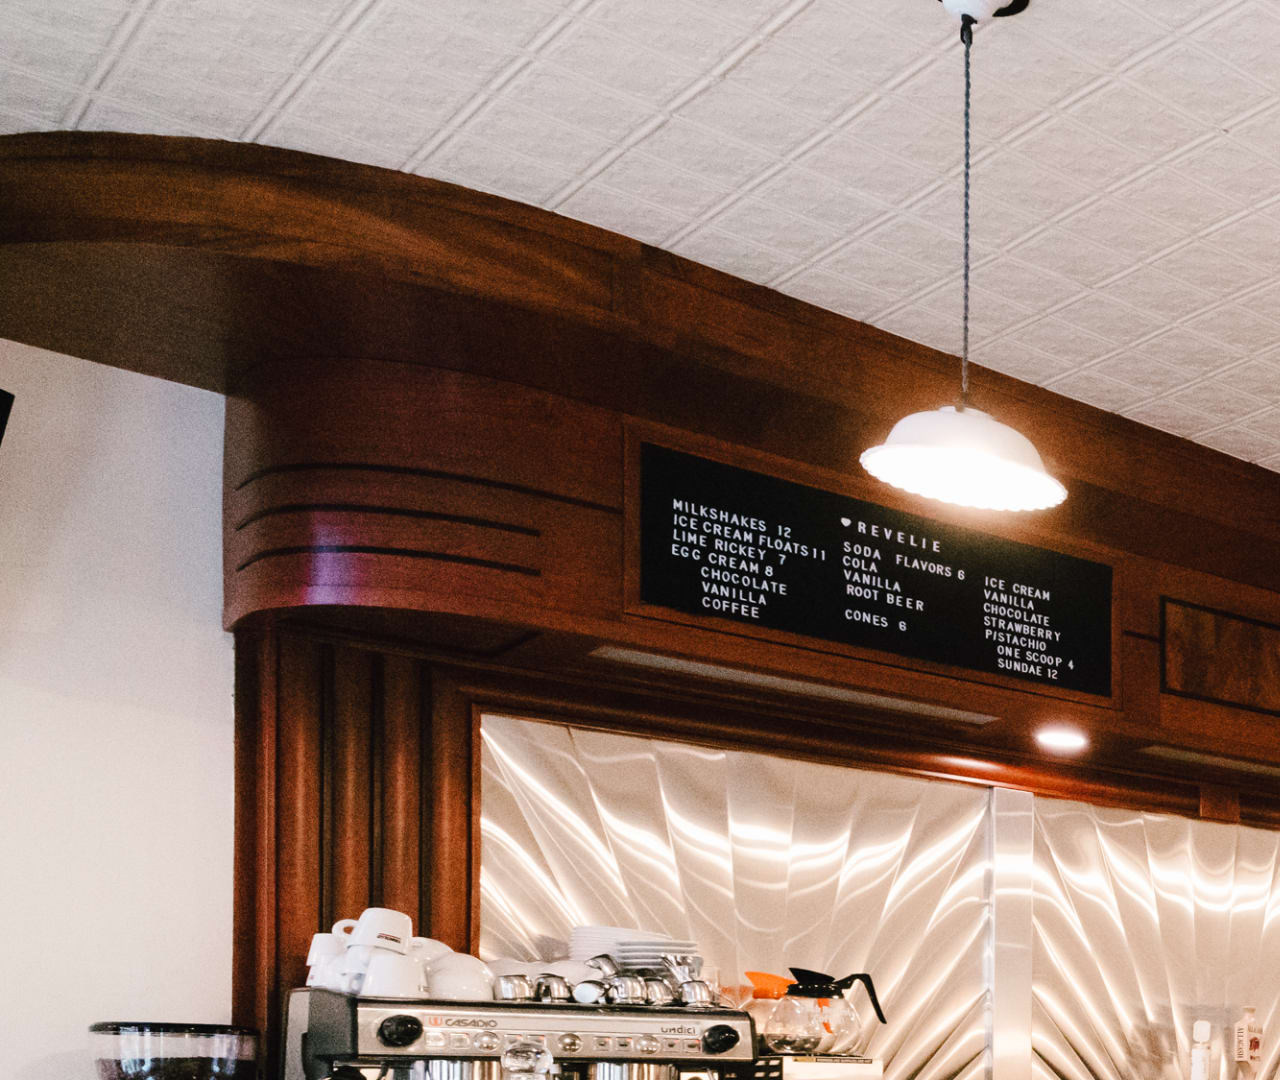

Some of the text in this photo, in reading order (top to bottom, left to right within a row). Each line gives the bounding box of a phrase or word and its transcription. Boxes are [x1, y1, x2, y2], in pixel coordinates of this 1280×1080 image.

[673, 498, 792, 538] MILKSHAKES 12
[673, 514, 826, 561] ICE CREAM FLOATS 11
[673, 528, 786, 565] LIME RICKEY 7
[857, 521, 941, 553] REVELIE
[671, 543, 774, 577] EGG CREAM 8
[842, 555, 878, 573] COLA
[843, 541, 965, 580] SODA FLAVORS 6
[700, 566, 788, 596] CHOCOLATE
[701, 581, 767, 606] VANILLA
[843, 569, 901, 593] VANILLA
[984, 576, 1050, 601] ICE CREAM
[702, 596, 760, 619] COFFEE
[846, 584, 924, 612] ROOT BEER
[983, 589, 1034, 611] VANILLA
[844, 609, 907, 632] CONES 6
[983, 602, 1050, 627] CHOCOLATE
[983, 616, 1061, 642] STRAWBERRY
[985, 629, 1047, 651] PISTACHIO
[997, 645, 1074, 670] ONE SCOOP 4
[997, 658, 1058, 680] SUNDAE 12
[445, 1018, 498, 1028] CASADIO
